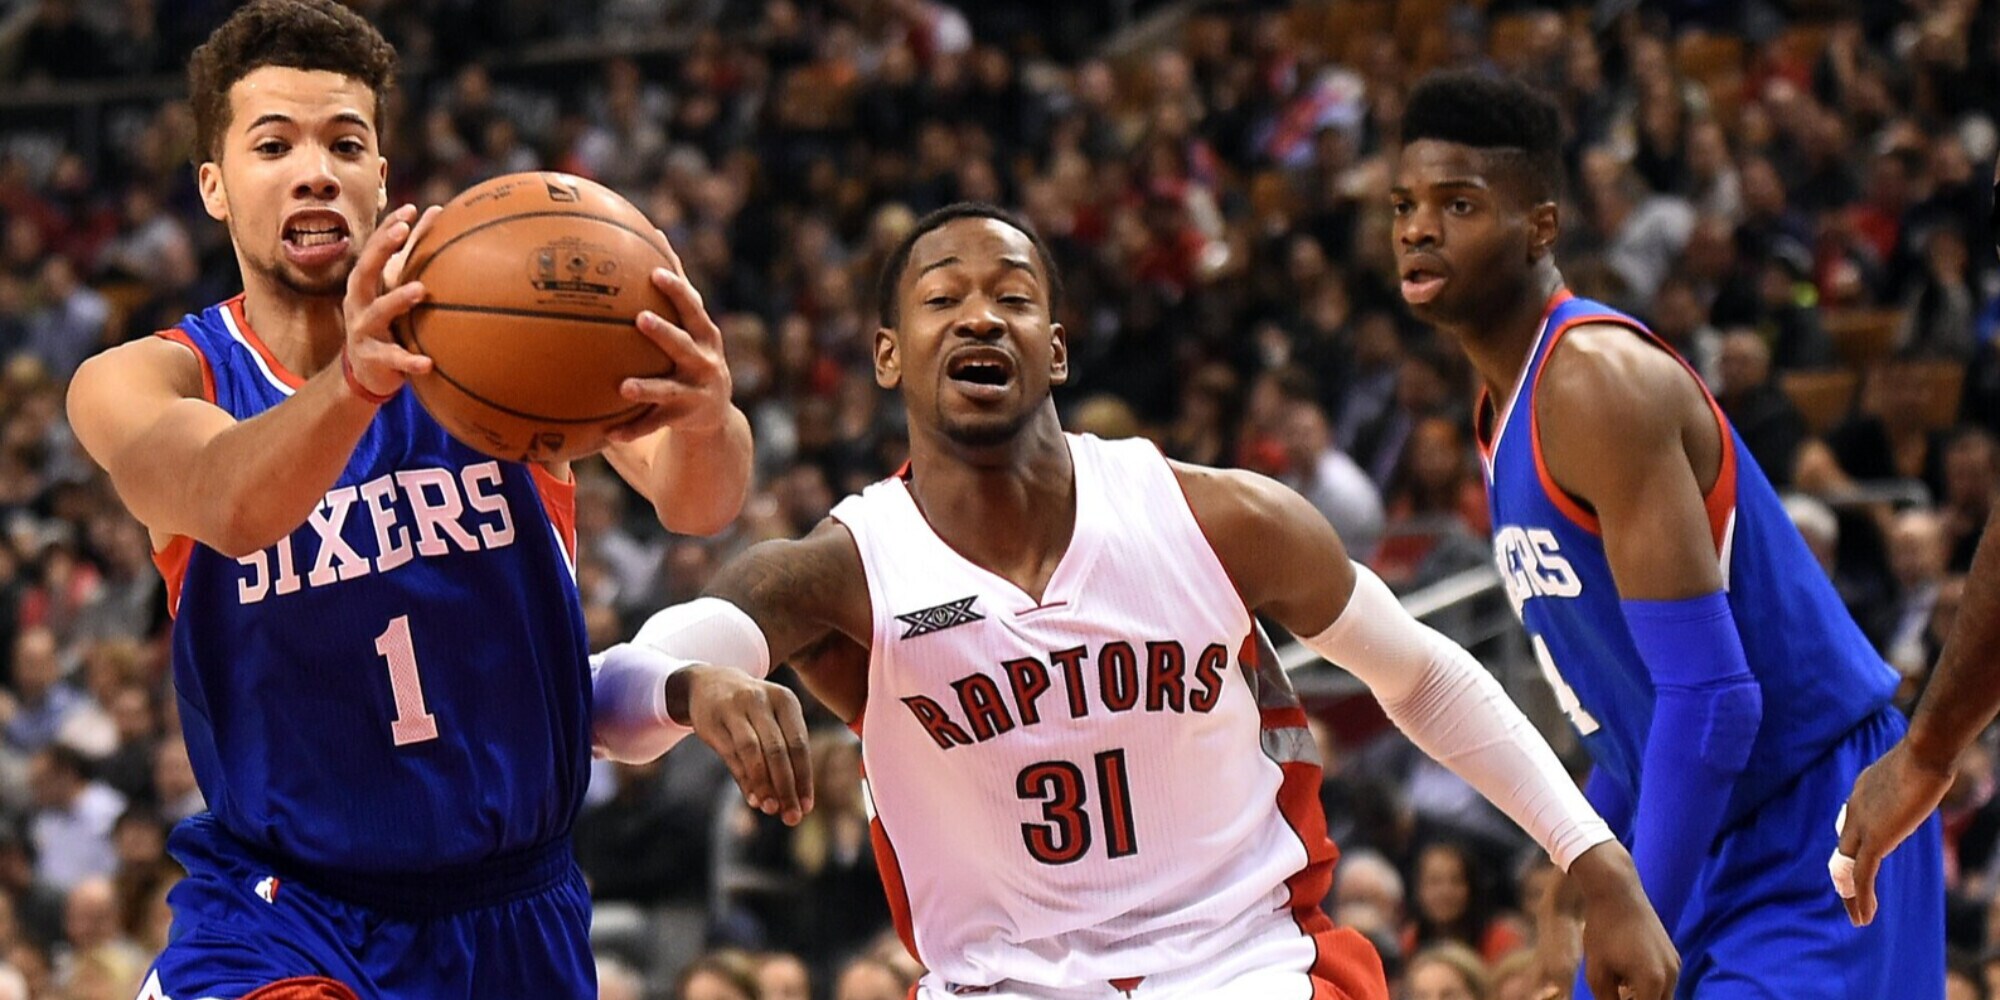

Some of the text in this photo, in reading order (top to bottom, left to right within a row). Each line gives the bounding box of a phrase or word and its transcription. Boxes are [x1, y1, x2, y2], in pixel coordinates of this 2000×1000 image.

[374, 614, 439, 746] 1
[900, 640, 1228, 750] RAPTORS
[1016, 748, 1138, 865] 31
